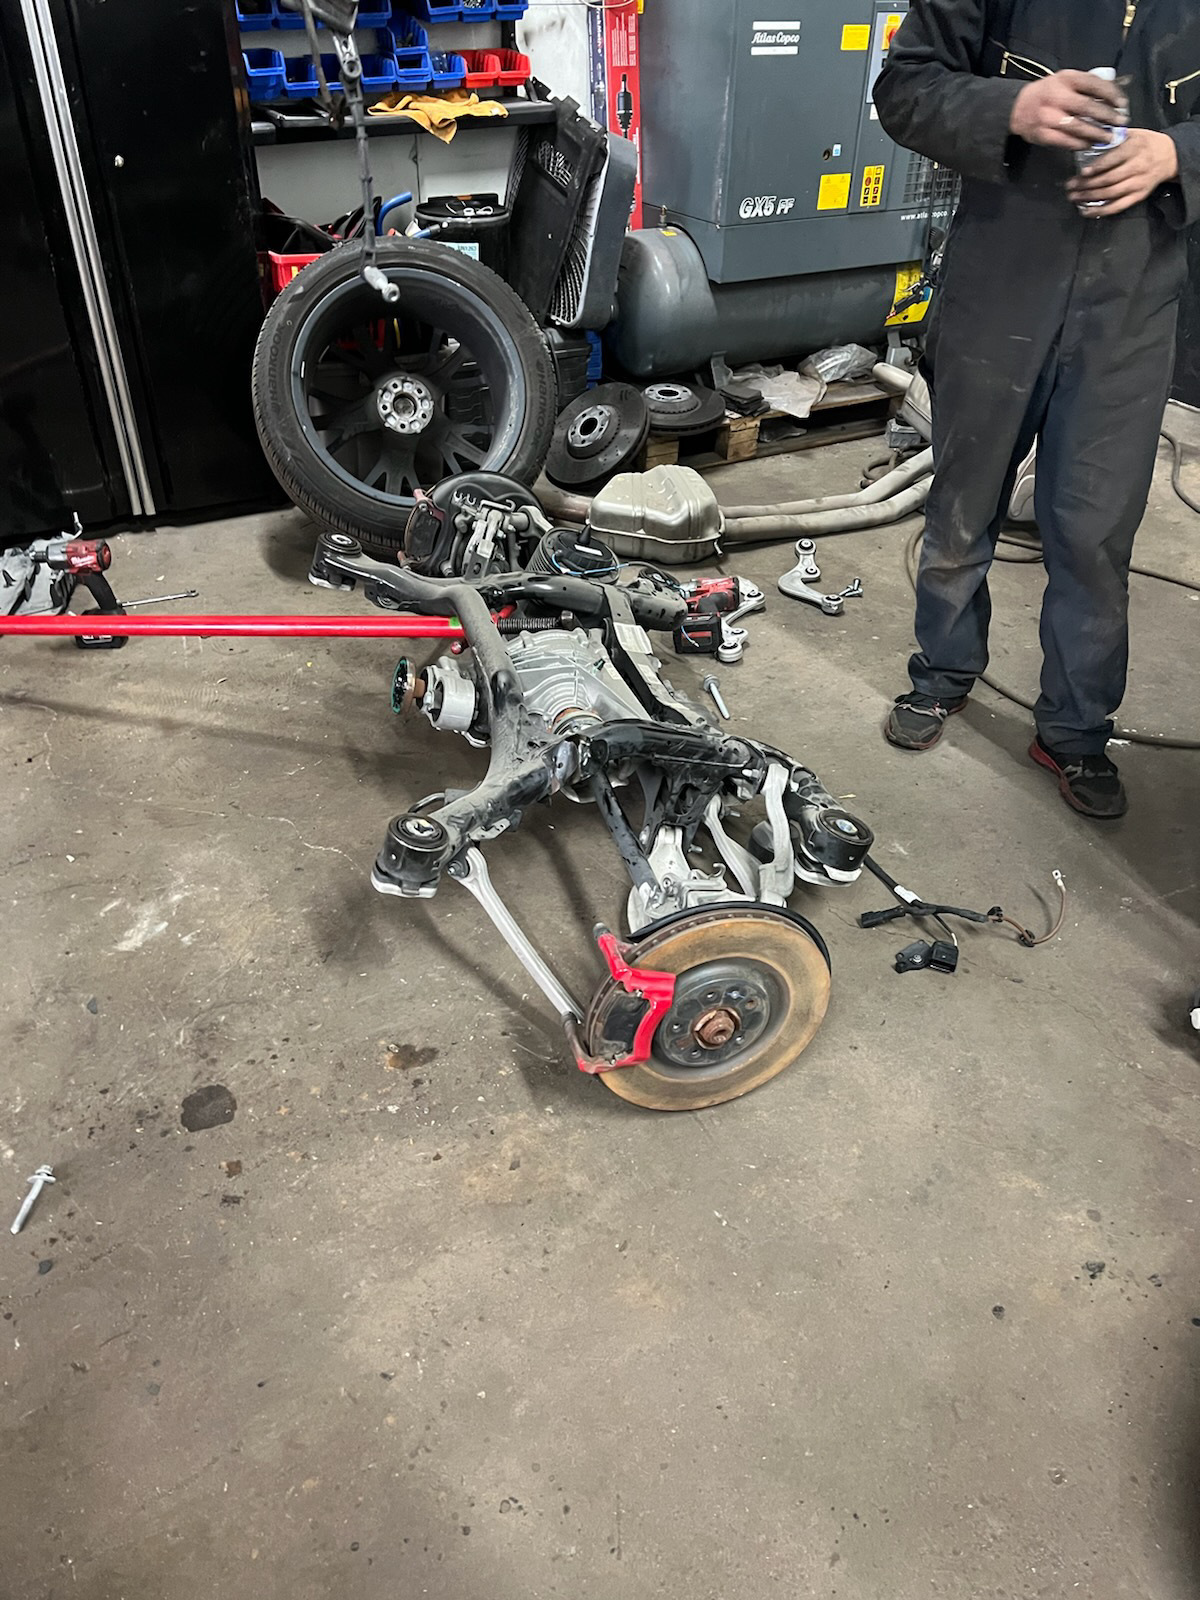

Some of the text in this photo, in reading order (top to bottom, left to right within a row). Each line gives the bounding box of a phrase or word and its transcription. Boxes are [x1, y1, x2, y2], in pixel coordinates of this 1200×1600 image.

[751, 31, 800, 45] Atlas Copco
[739, 196, 795, 219] GX5 FF
